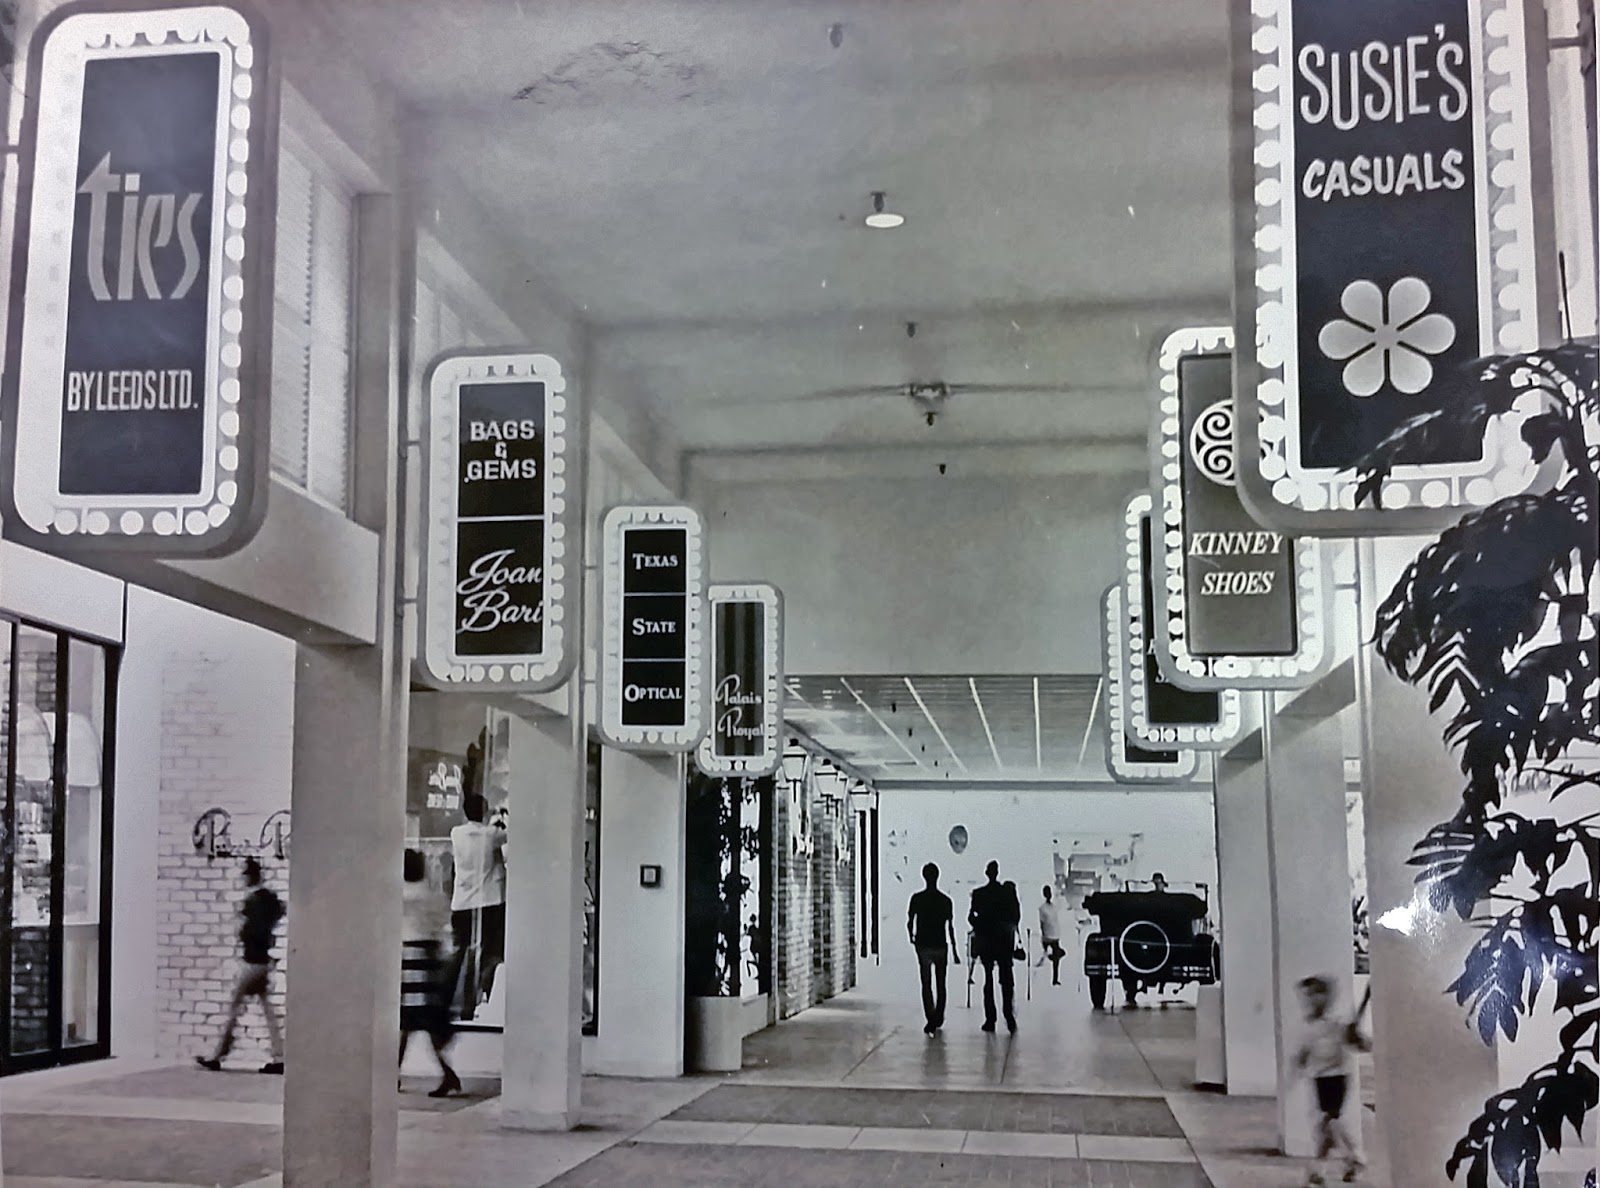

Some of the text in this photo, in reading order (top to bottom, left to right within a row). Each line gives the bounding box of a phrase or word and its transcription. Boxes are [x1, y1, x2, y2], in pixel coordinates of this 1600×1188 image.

[1298, 24, 1468, 130] SUSIE'S
[1302, 149, 1466, 201] CASUALS
[67, 369, 199, 411] BY LEEDS LTD.
[470, 420, 535, 441] BAGS
[495, 441, 507, 459] &
[467, 459, 537, 480] GEMS
[1188, 531, 1283, 555] KINNEY
[457, 548, 542, 595] Joan
[1200, 571, 1275, 595] SHOES
[456, 586, 544, 634] Bari
[714, 674, 762, 706] Palais
[717, 706, 764, 741] Royal
